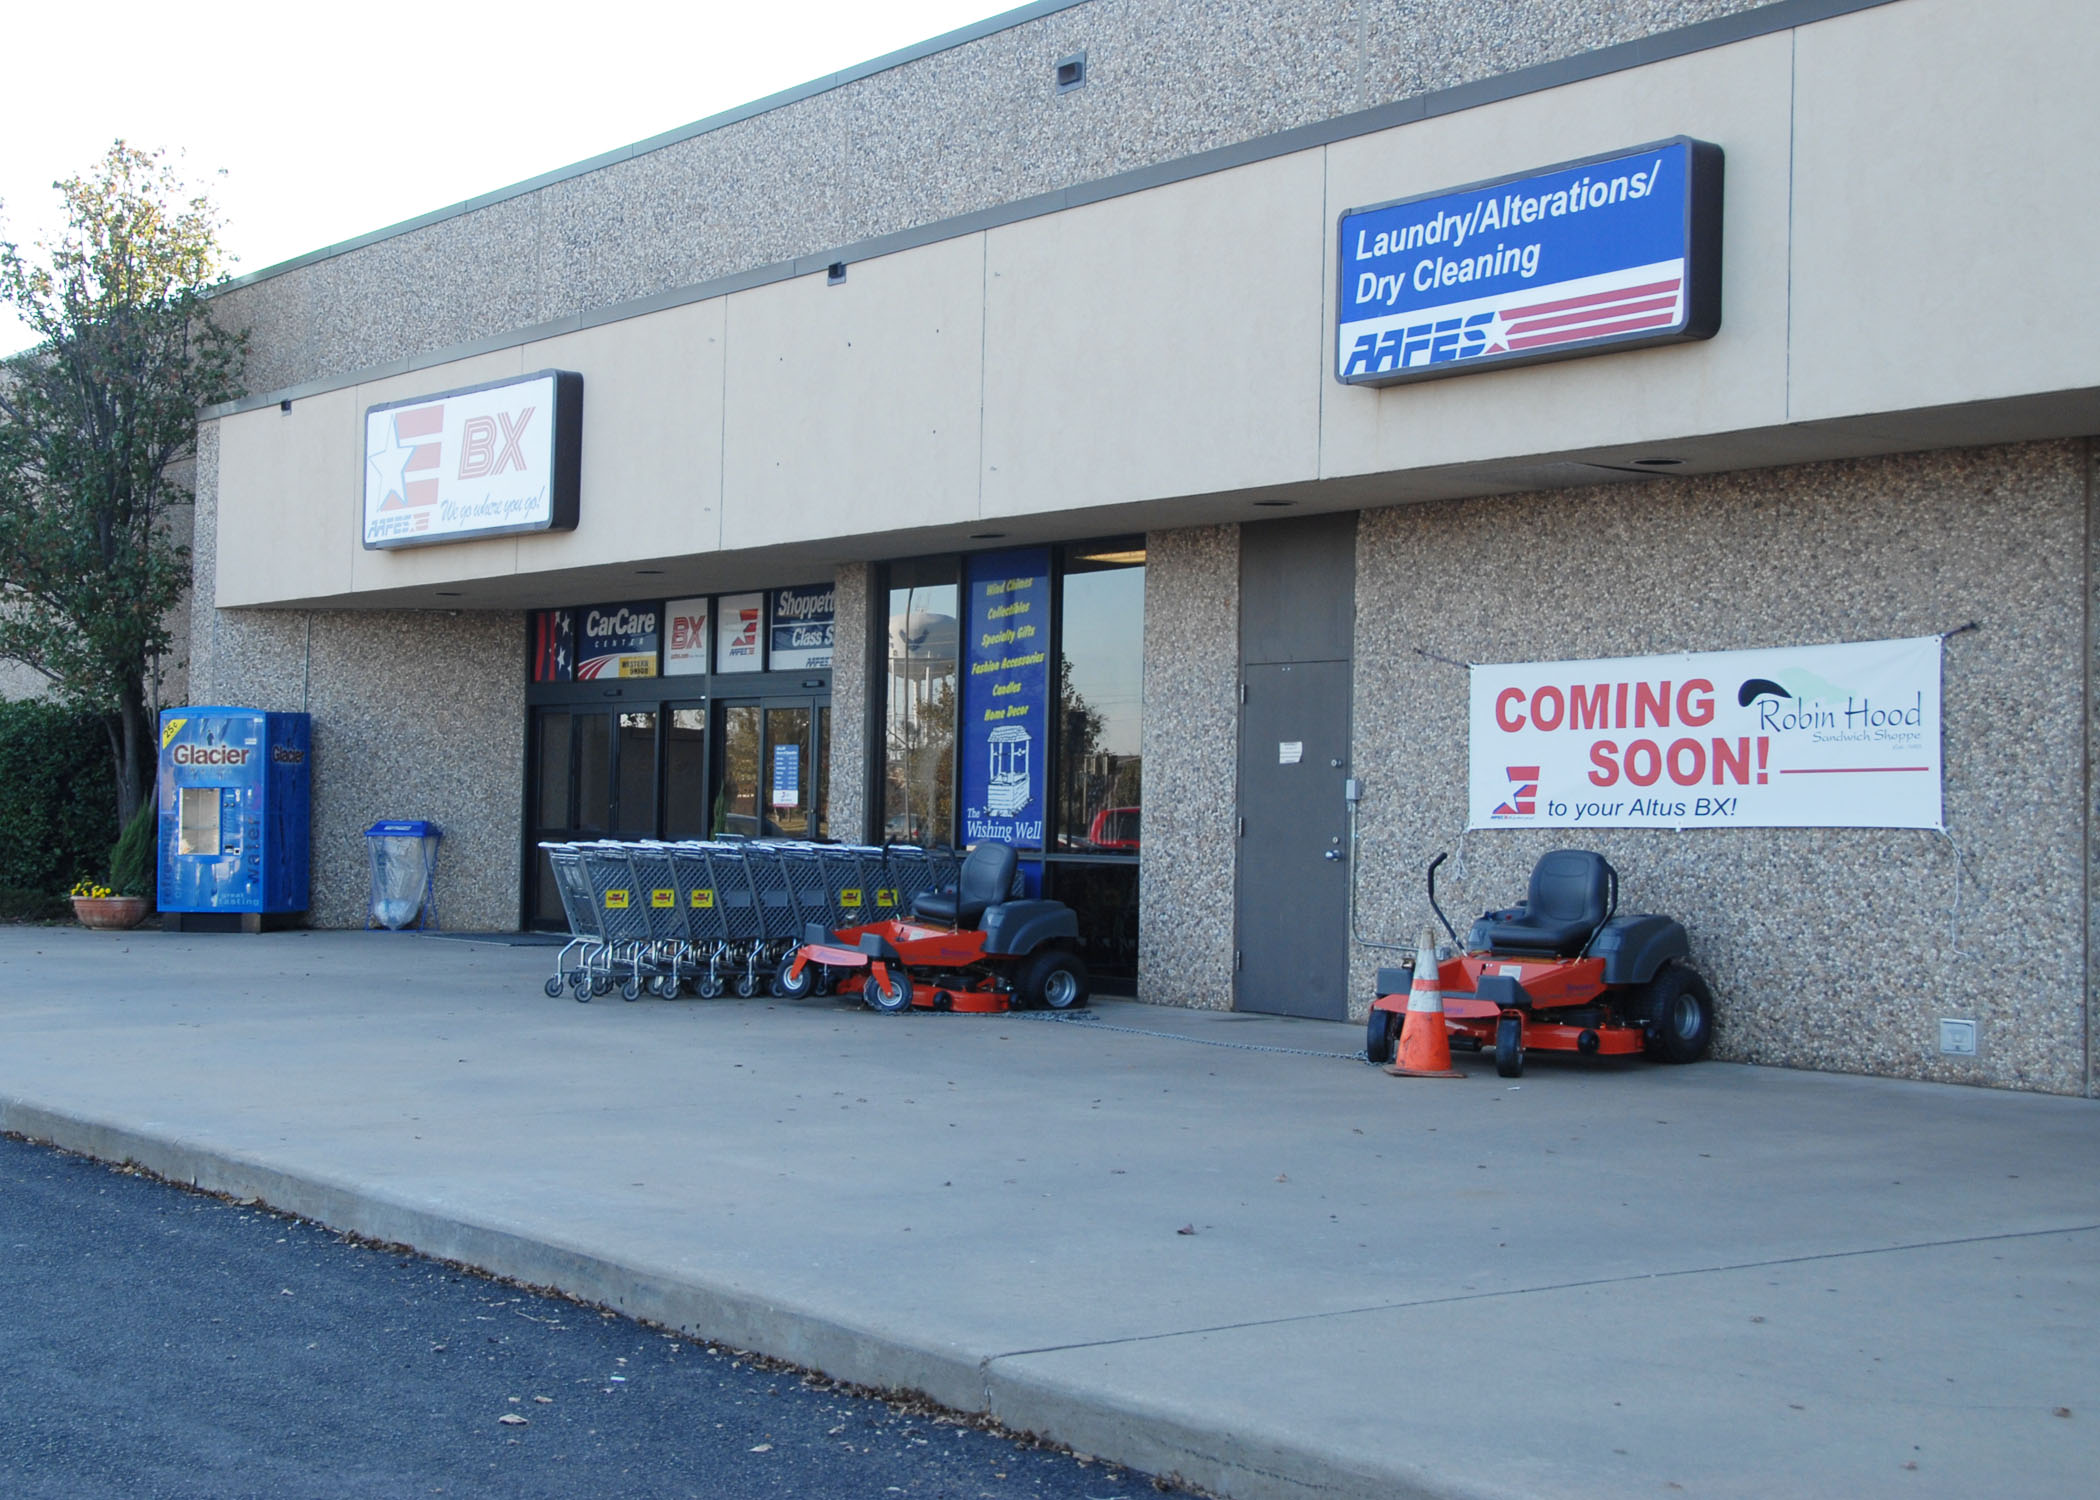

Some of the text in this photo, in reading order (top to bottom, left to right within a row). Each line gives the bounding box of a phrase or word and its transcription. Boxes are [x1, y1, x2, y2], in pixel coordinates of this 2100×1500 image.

[1355, 159, 1662, 261] Laundry/Alterations/
[1355, 244, 1541, 306] Dry Cleaning
[1343, 311, 1496, 375] AAFES
[457, 406, 536, 480] BX
[440, 486, 545, 527] We go where you go!
[367, 514, 412, 538] AAFES
[986, 577, 1034, 596] Wind Chimes
[586, 608, 655, 637] CarCare
[987, 601, 1031, 620] Collectibles
[594, 637, 644, 648] CENTER
[671, 616, 706, 650] BX
[792, 626, 823, 647] Class
[981, 624, 1035, 648] Specialty Gifts
[971, 650, 1045, 675] Fashion Accessories
[992, 681, 1022, 697] Candles
[984, 705, 1029, 721] Home Decor
[1495, 678, 1715, 733] COMING
[1757, 691, 1921, 733] Robin Hood
[1812, 728, 1921, 743] Sandwich Shoppe
[173, 745, 249, 765] Glacier
[273, 744, 305, 763] Glacier
[1587, 736, 1770, 788] SOON!
[967, 807, 980, 819] The
[1548, 797, 1737, 821] to your Altus BX!
[967, 820, 1042, 843] Wishing Well
